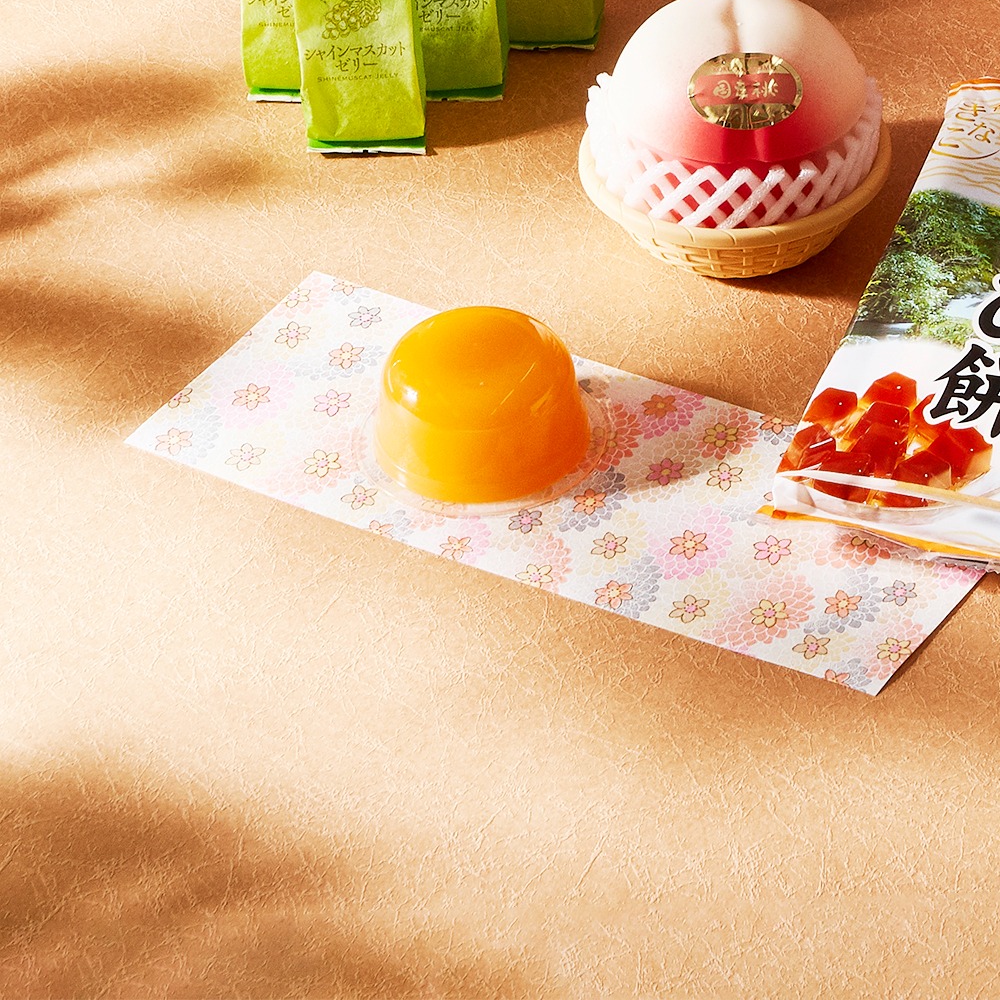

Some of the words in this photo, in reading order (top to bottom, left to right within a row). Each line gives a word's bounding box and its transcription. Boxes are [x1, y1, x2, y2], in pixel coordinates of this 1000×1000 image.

[419, 9, 460, 24] ゼリー
[304, 41, 406, 60] シャインマスカット
[336, 58, 378, 73] ゼリー
